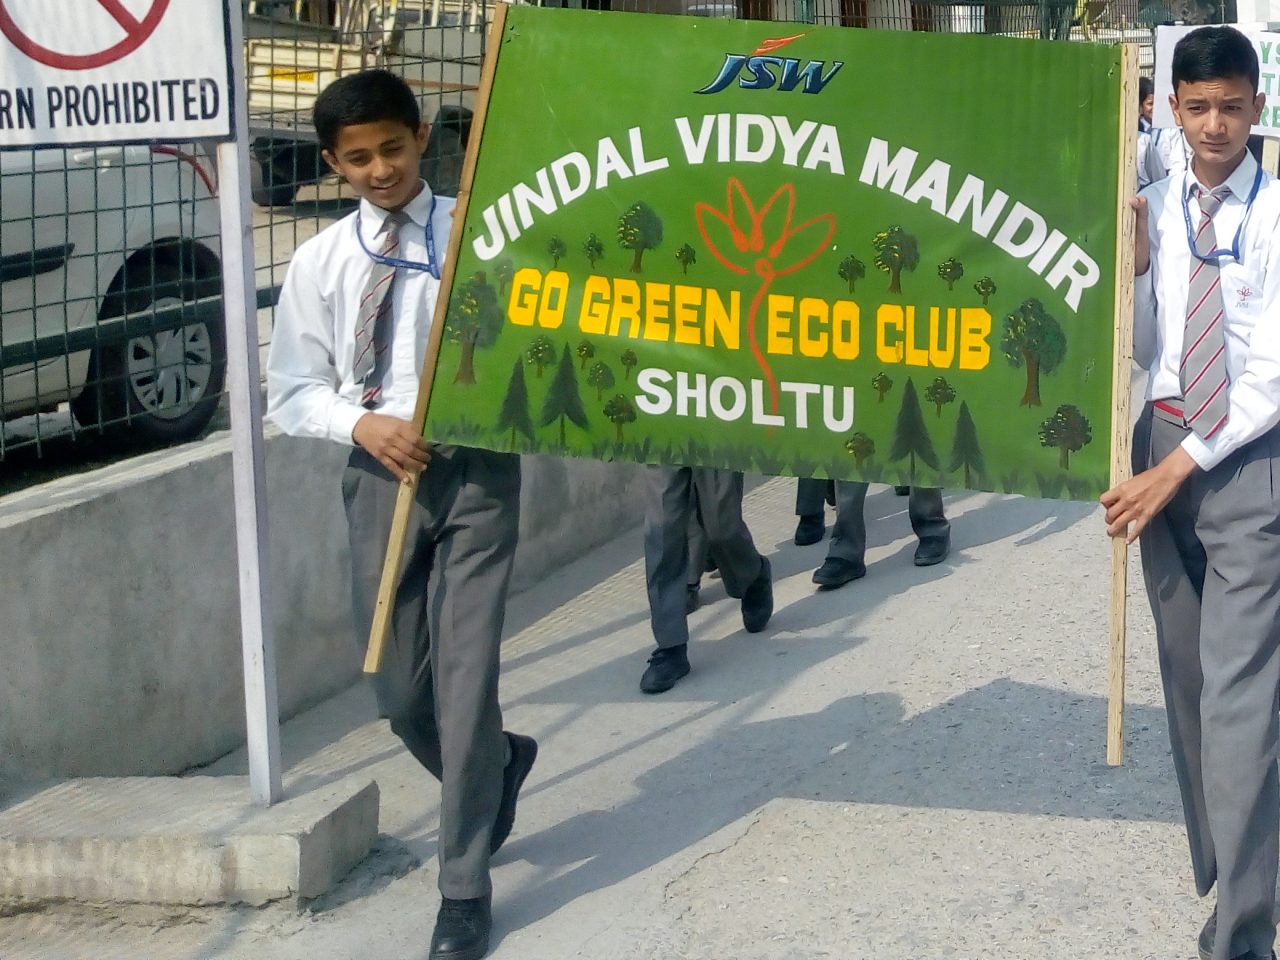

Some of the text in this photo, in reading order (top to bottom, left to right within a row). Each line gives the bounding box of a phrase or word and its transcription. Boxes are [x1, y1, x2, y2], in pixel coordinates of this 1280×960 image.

[0, 78, 220, 130] RN PROHIBITED
[693, 52, 845, 95] JSW
[471, 112, 1101, 313] JINDAL VIDYA MANDIR
[507, 267, 992, 370] GO GREEN ECO CLUB
[634, 367, 855, 433] SHOLTU
